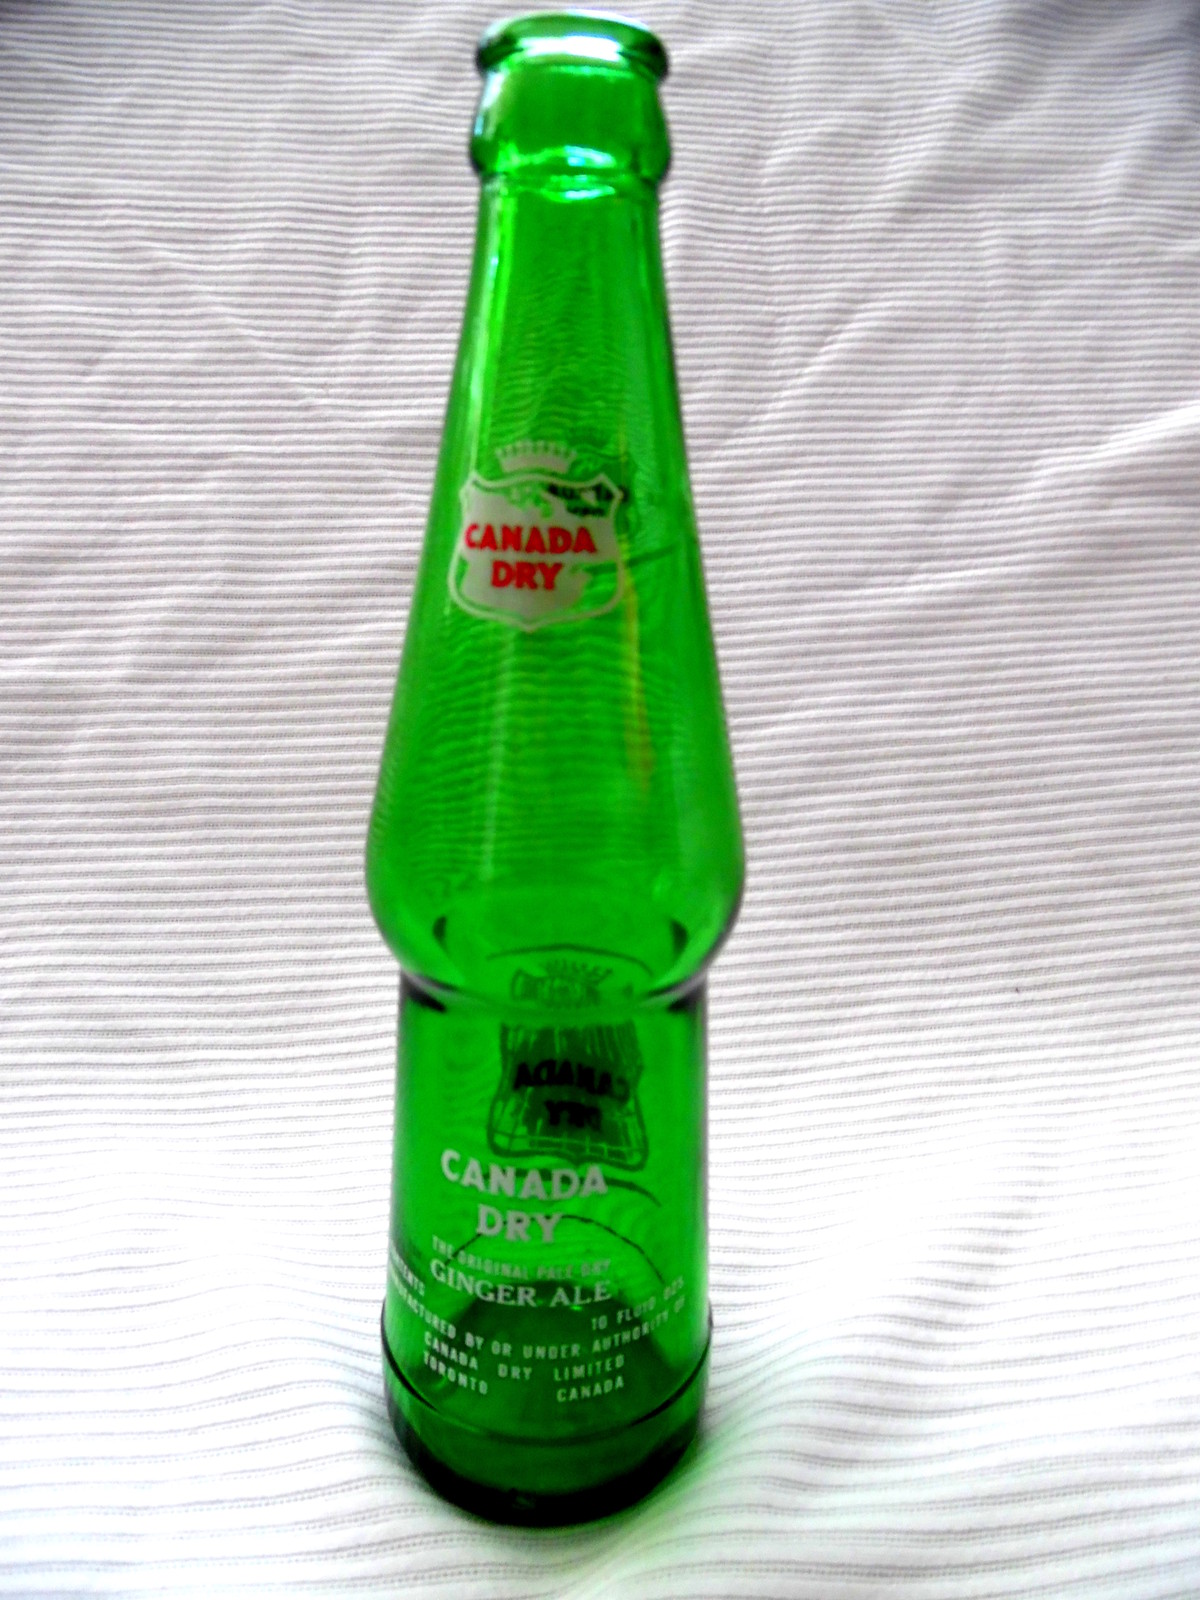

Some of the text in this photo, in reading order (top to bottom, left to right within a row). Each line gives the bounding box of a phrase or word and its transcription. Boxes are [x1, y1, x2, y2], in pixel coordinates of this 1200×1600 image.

[464, 523, 597, 554] CANADA
[491, 560, 563, 590] DRY
[440, 1149, 608, 1201] CANADA
[477, 1204, 564, 1243] DRY
[432, 1234, 454, 1260] THE
[457, 1249, 529, 1280] ORIGINAL
[430, 1258, 612, 1307] GINGER ALE
[617, 1295, 656, 1324] FLUID
[424, 1330, 624, 1381] CANADA DRY LIMITED
[465, 1332, 484, 1350] BY
[491, 1336, 513, 1356] OR
[522, 1344, 581, 1360] UNDER
[592, 1309, 669, 1352] AUTHORITY
[423, 1350, 624, 1403] TORONTO CANADA
